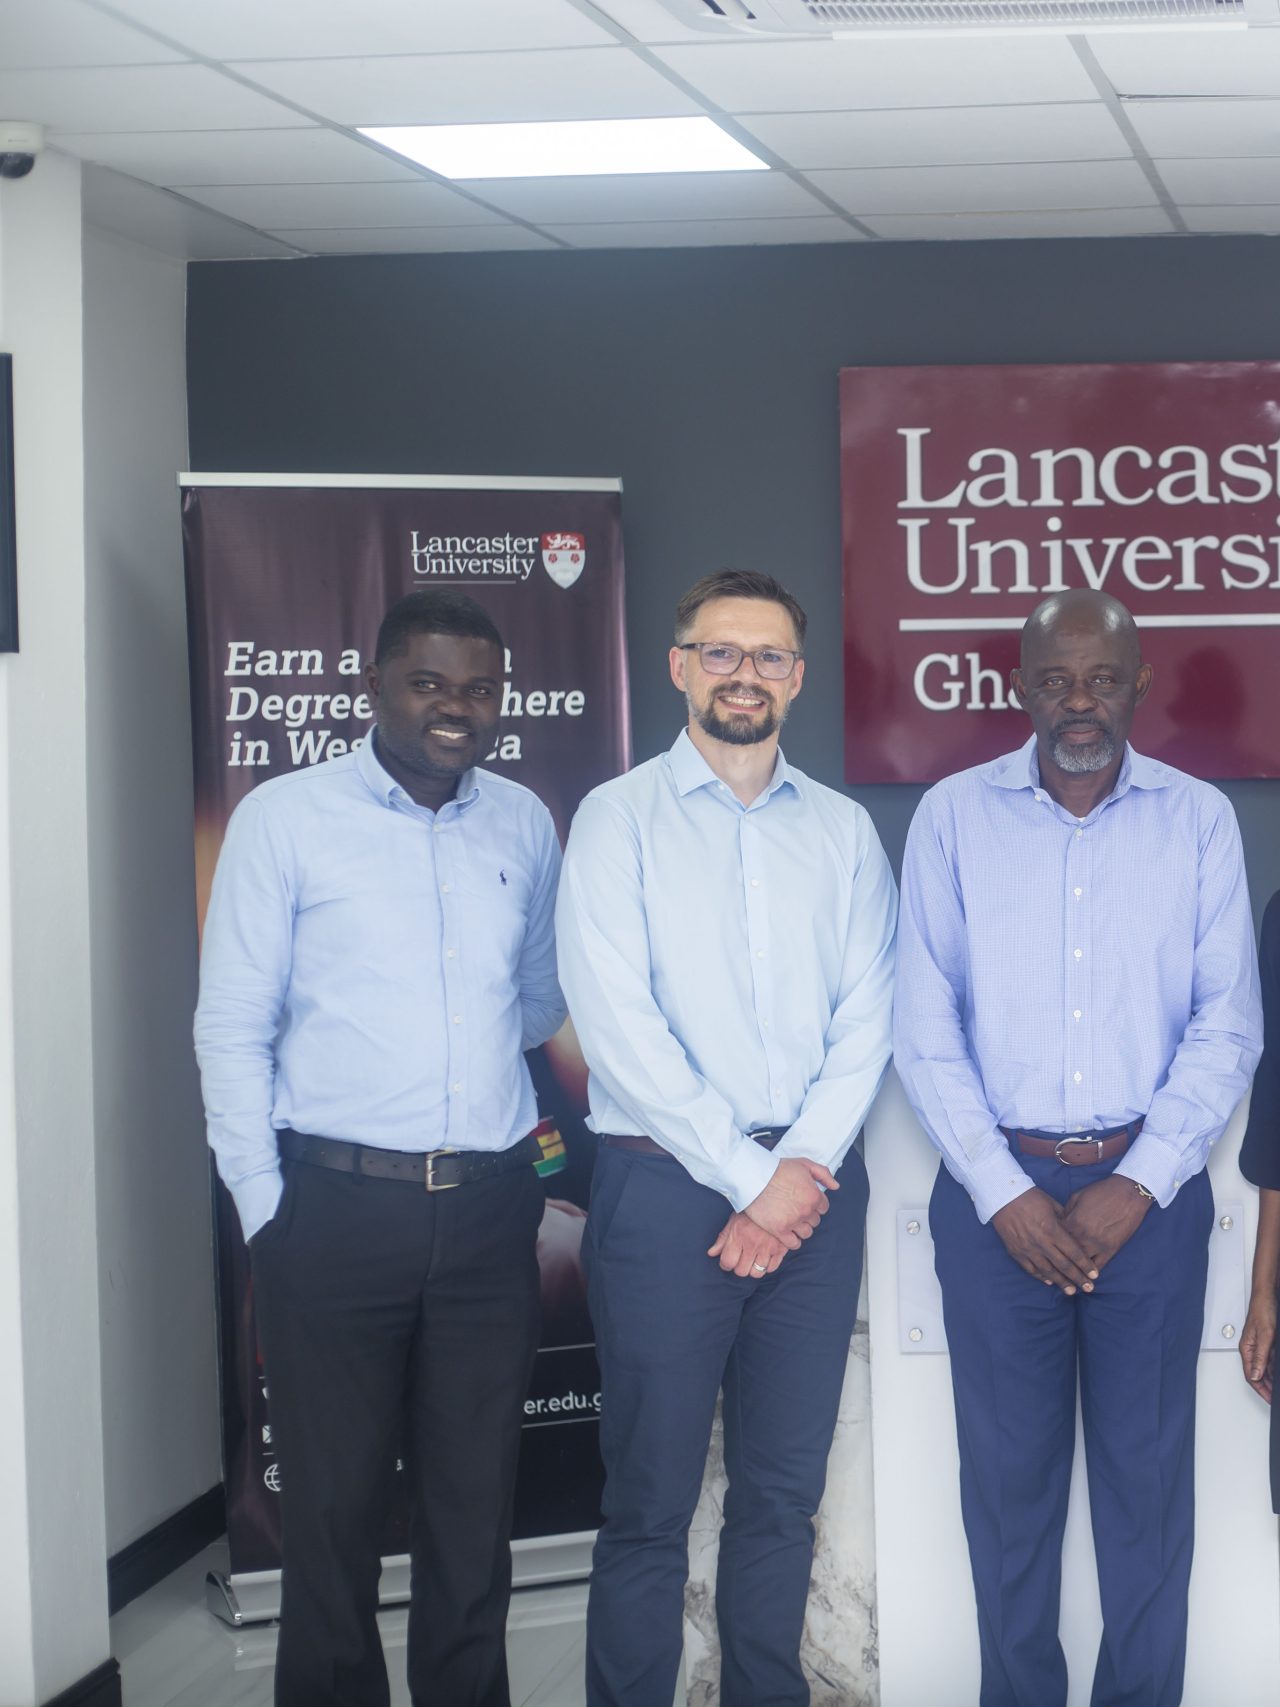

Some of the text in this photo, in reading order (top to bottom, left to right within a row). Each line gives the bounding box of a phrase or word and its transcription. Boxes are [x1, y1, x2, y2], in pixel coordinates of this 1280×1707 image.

[411, 531, 539, 554] Lancaster
[412, 553, 535, 580] University
[224, 641, 361, 676] Earn a
[226, 687, 373, 727] Degree
[228, 731, 270, 766] in
